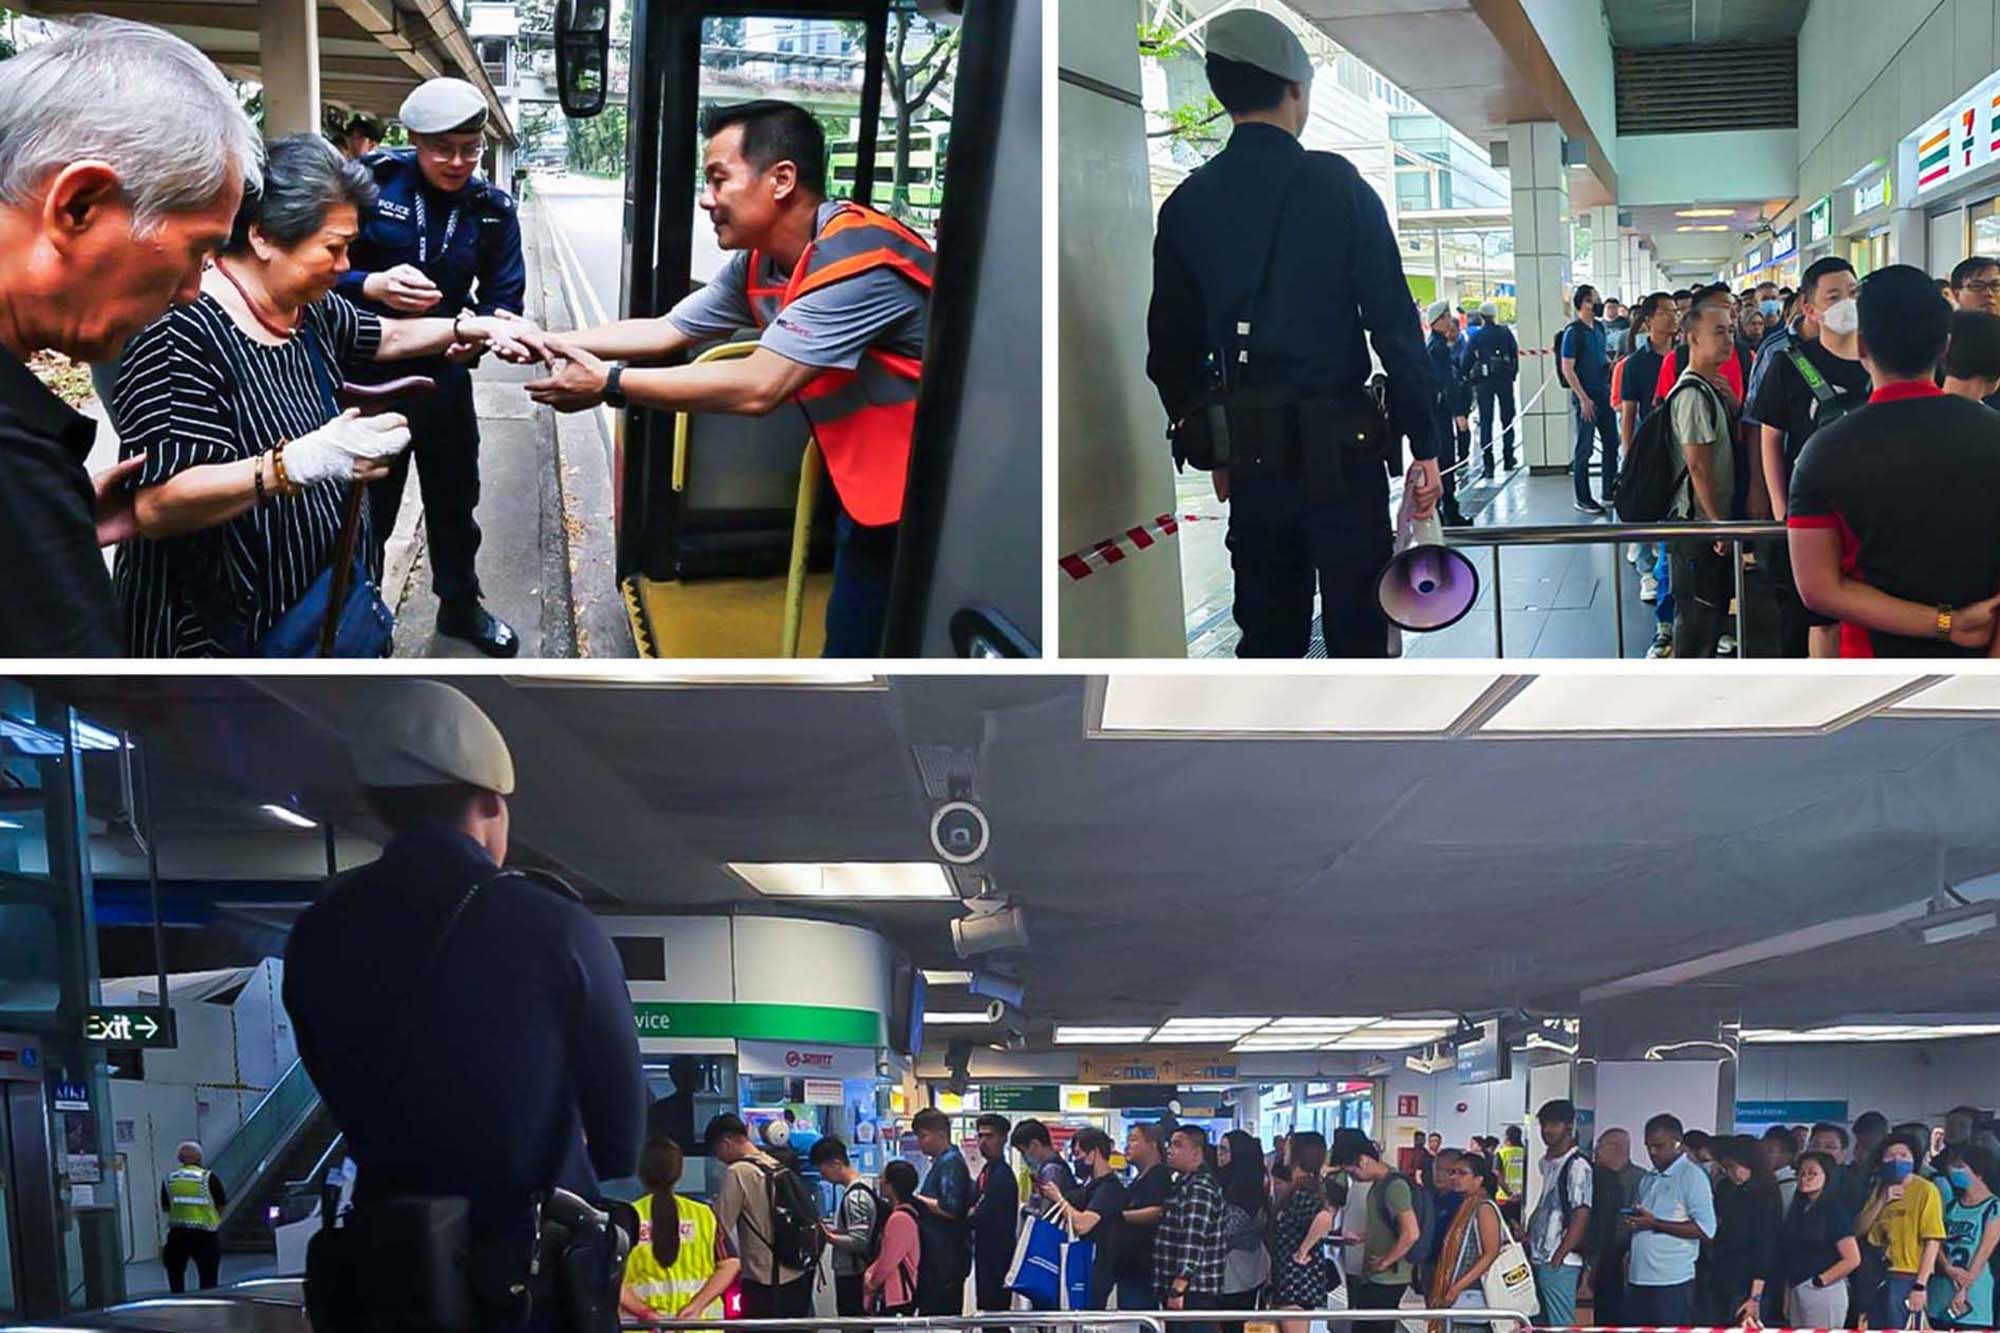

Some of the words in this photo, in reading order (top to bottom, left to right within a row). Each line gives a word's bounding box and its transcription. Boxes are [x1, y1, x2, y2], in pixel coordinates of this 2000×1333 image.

[378, 199, 410, 215] POLICE
[83, 1014, 132, 1040] Exit
[634, 1012, 670, 1030] vice
